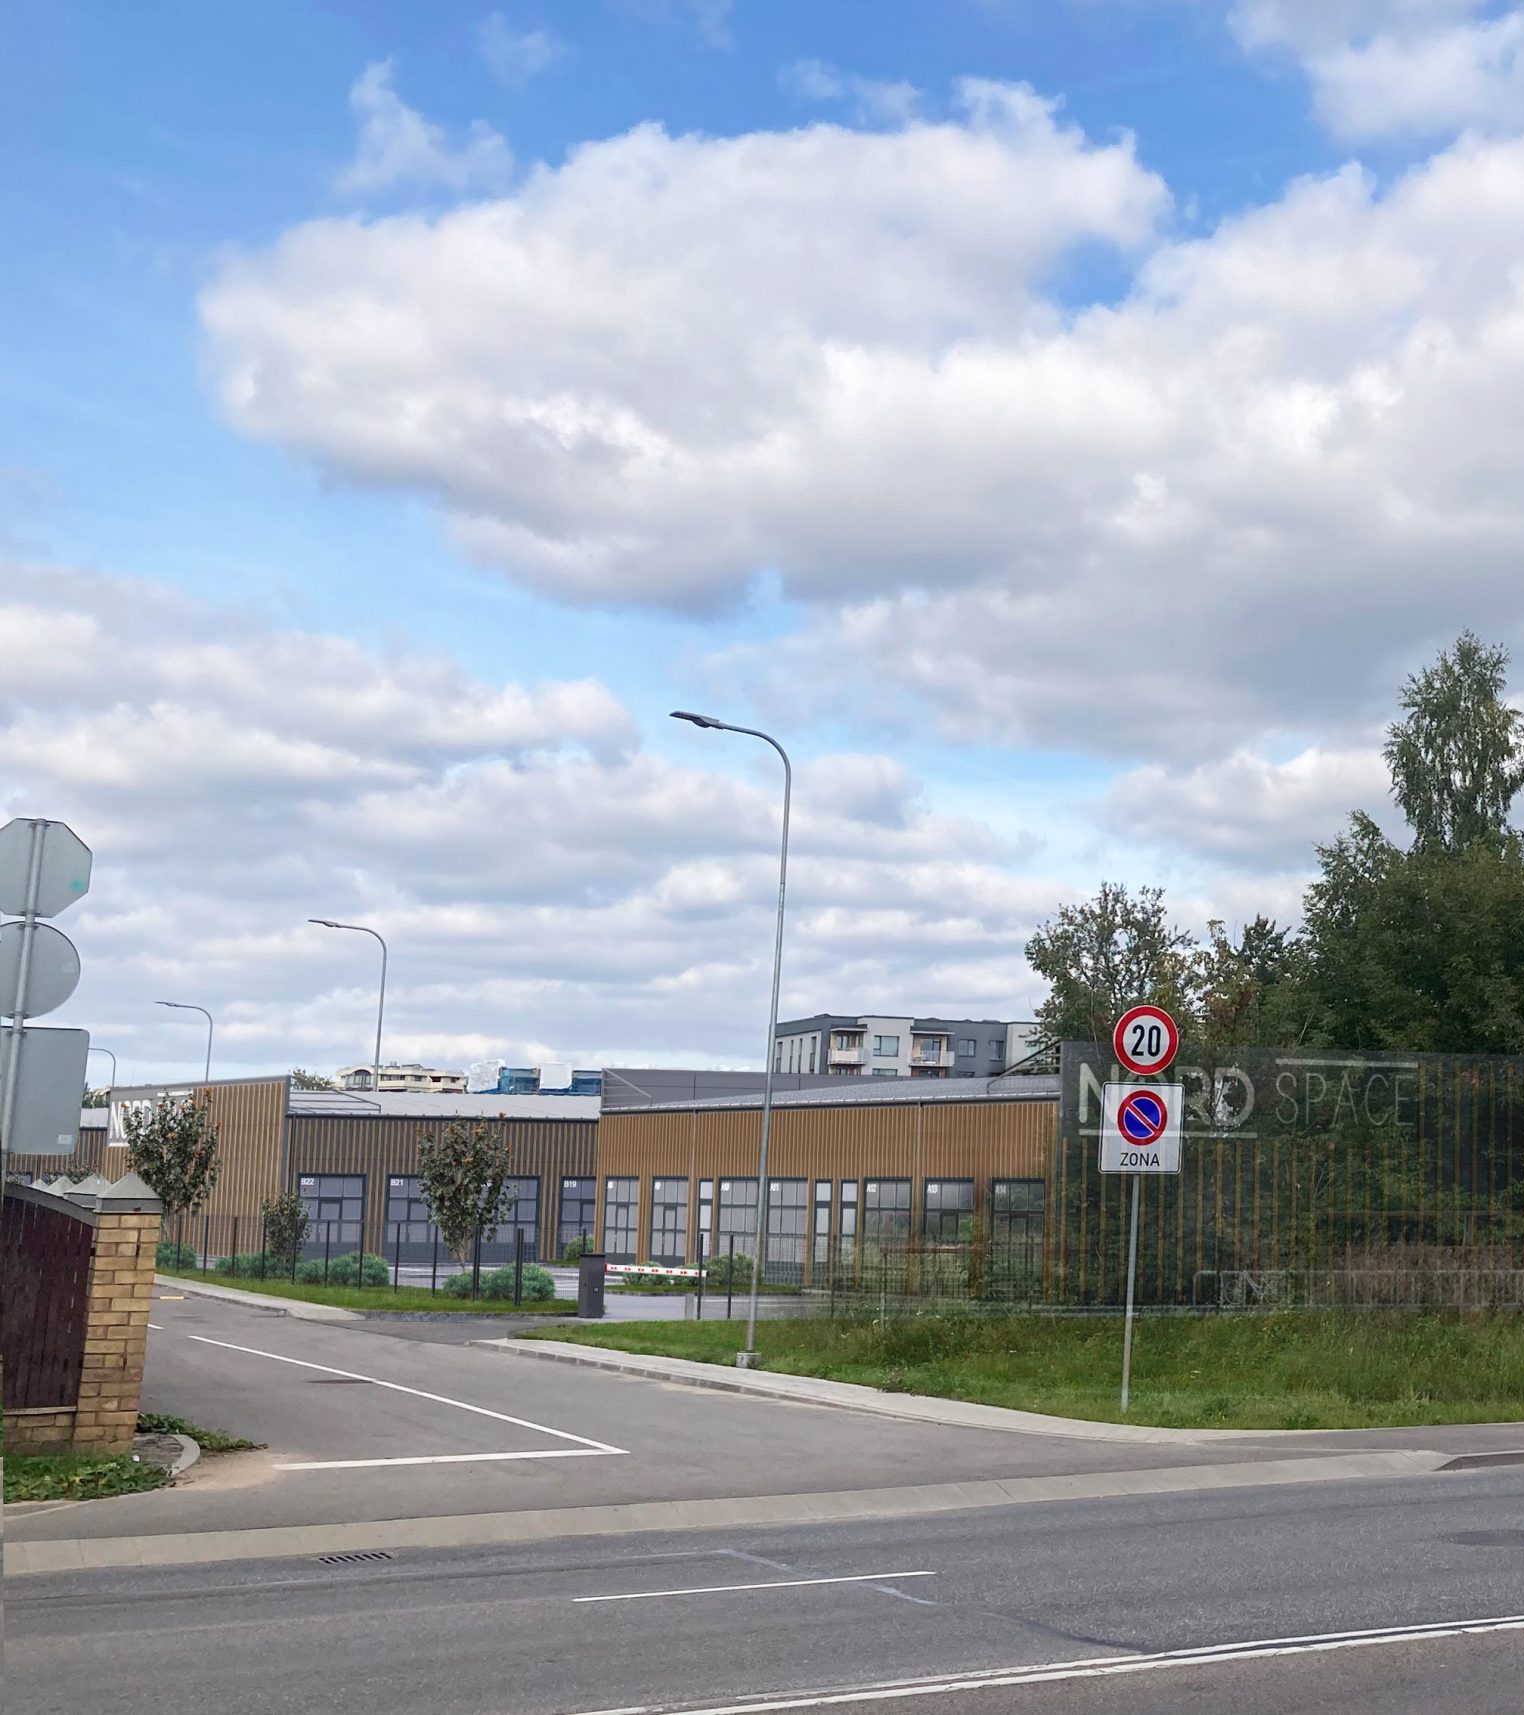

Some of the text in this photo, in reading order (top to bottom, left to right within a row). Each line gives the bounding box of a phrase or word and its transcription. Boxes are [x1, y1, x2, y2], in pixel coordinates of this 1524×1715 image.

[1131, 1024, 1161, 1057] 20
[1276, 1072, 1414, 1127] SPACE
[1120, 1152, 1160, 1167] ZONA
[300, 1178, 315, 1186] B22
[390, 1179, 404, 1187] B21
[563, 1180, 577, 1188] B19
[866, 1183, 877, 1193] A12
[927, 1184, 938, 1194] A13
